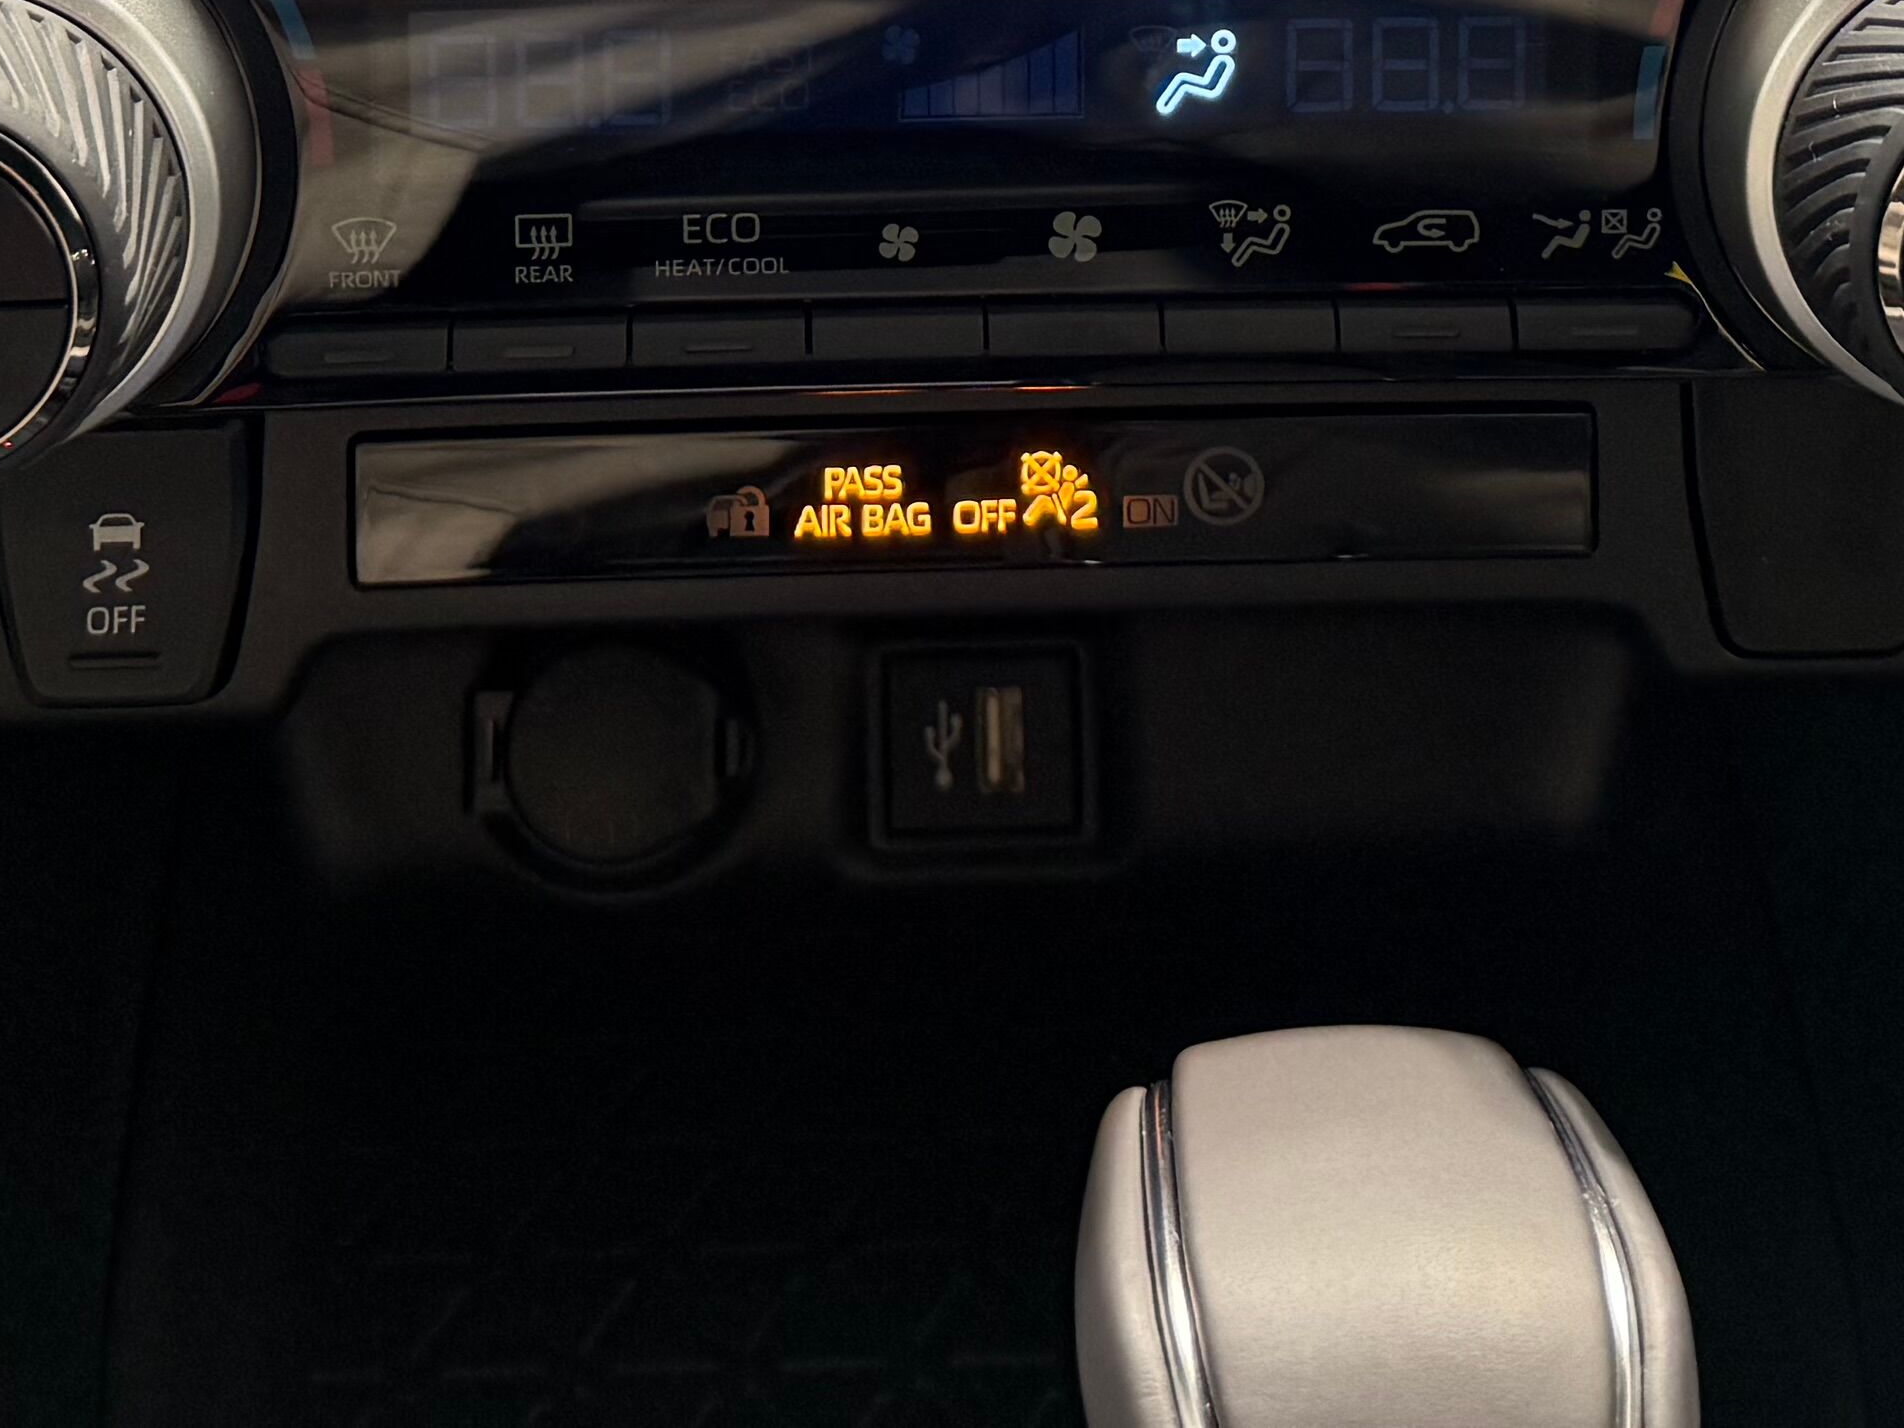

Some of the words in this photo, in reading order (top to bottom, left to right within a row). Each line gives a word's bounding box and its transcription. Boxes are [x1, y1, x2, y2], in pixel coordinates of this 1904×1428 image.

[682, 213, 761, 244] ECO
[328, 269, 401, 289] FRONT
[514, 264, 574, 284] REAR
[654, 256, 790, 277] HEAT/COOL
[823, 465, 903, 500] PASS
[793, 504, 852, 538] AIR
[860, 501, 932, 536] BAG
[952, 499, 1017, 533] OFF
[1127, 498, 1176, 525] ON
[86, 605, 146, 635] OFF
